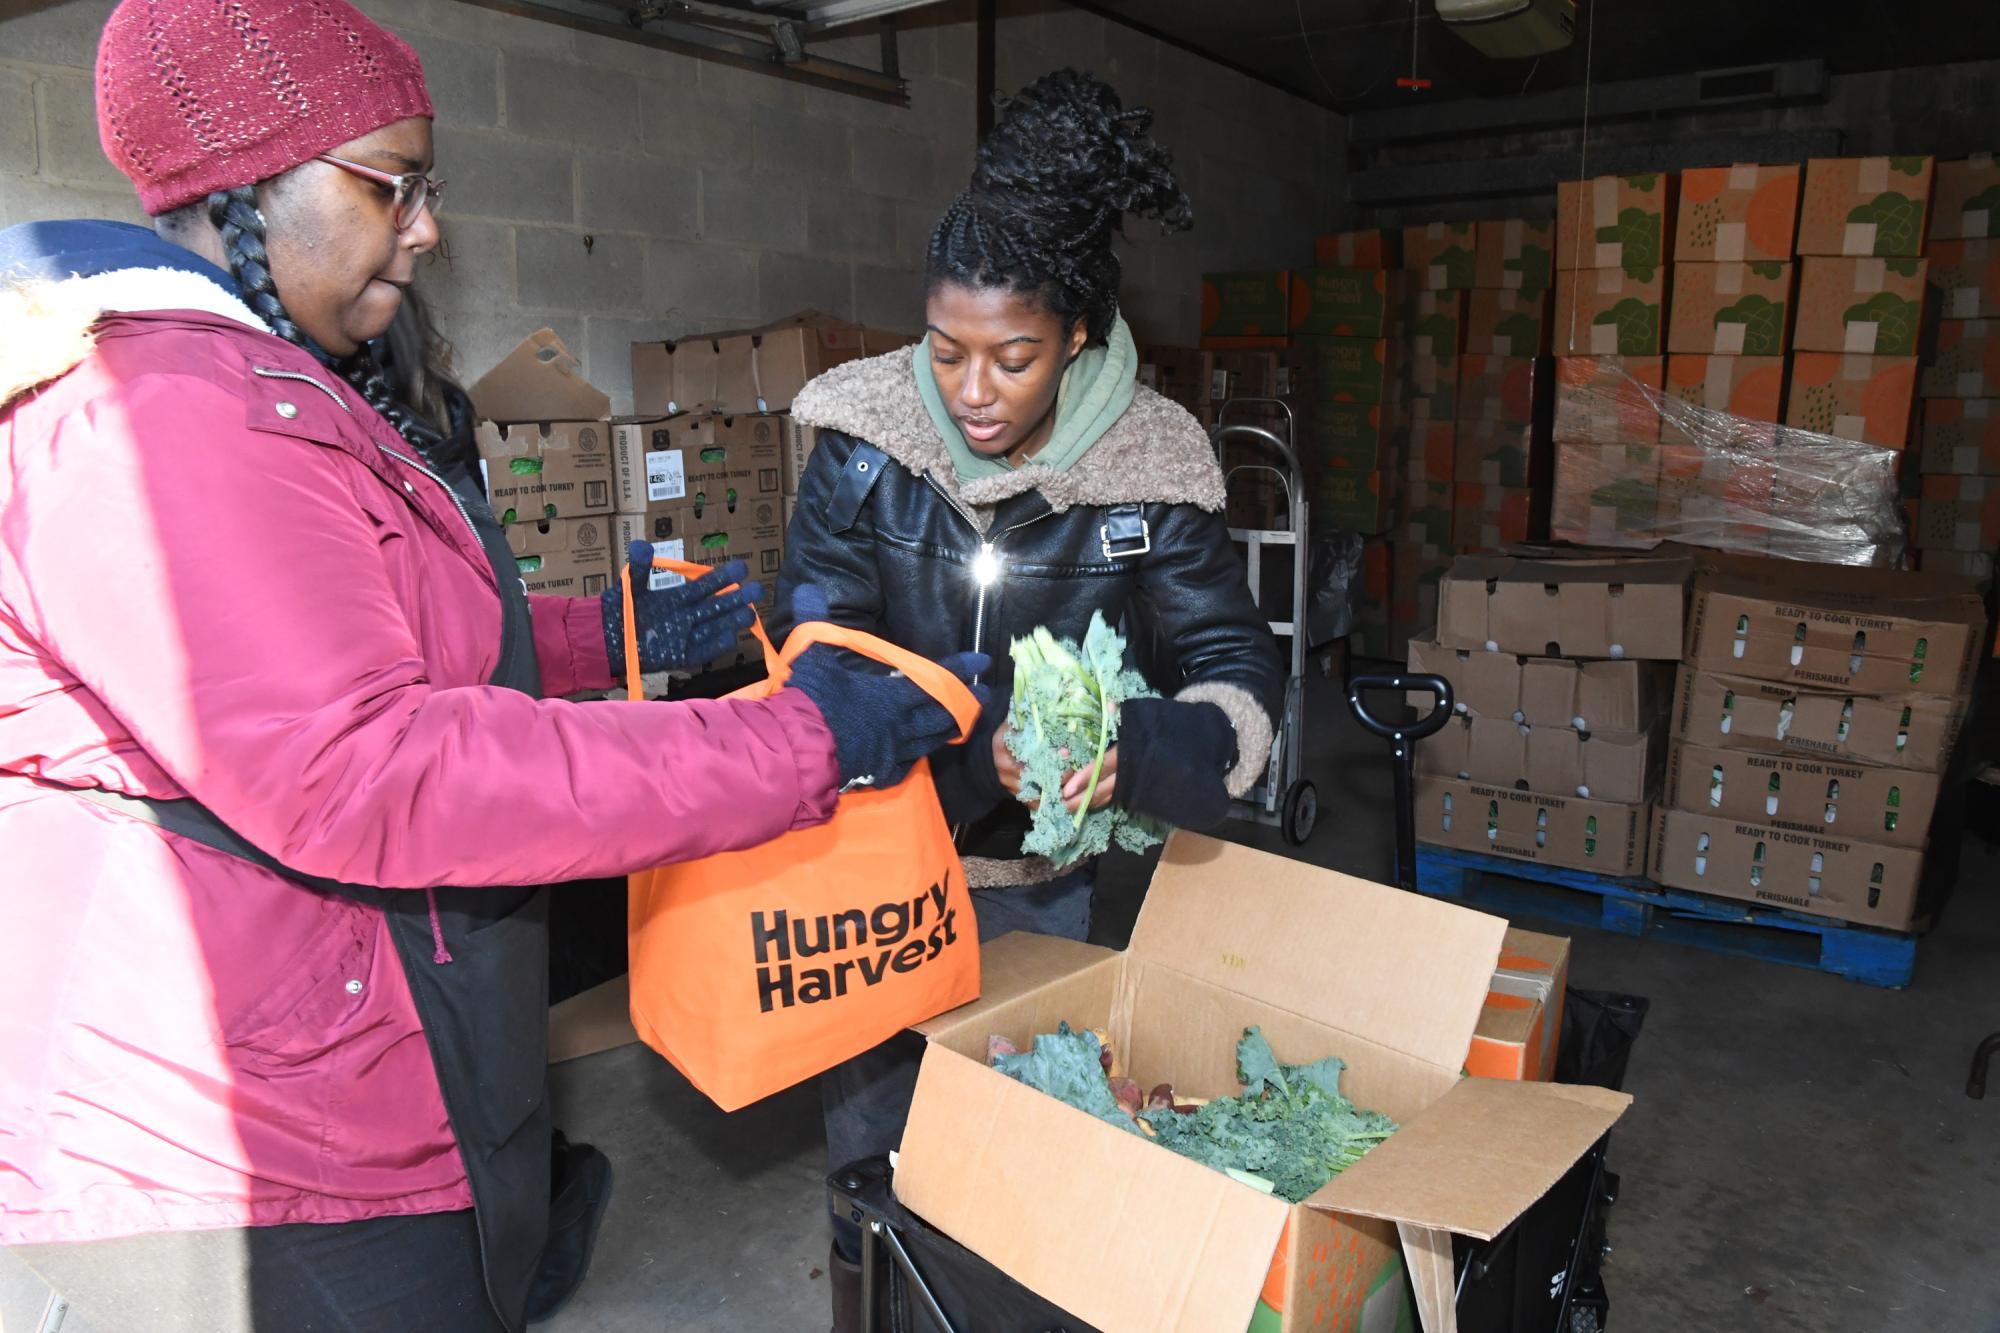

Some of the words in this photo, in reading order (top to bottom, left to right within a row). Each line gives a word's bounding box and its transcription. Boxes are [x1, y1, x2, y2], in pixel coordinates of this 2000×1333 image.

[619, 430, 629, 465] PRODUCT
[795, 424, 803, 451] RODUCT
[621, 466, 630, 478] OF
[494, 487, 518, 498] READY
[520, 486, 529, 495] TO
[549, 482, 575, 491] TURKEY
[623, 479, 632, 502] U.S.A.
[526, 580, 546, 592] COOK
[547, 578, 574, 589] TURKEY
[1775, 606, 1806, 619] READY
[1808, 612, 1822, 621] TO
[1824, 614, 1851, 625] COOK
[1854, 617, 1894, 631] TURKEY
[1794, 669, 1851, 686] PERISHABLE
[1760, 685, 1793, 696] READY
[1783, 735, 1838, 753] PERISHABLE
[1747, 757, 1778, 769] READY
[1781, 761, 1793, 771] TO
[1795, 763, 1823, 775] COOK
[1825, 766, 1864, 779] TURKEY
[1470, 786, 1495, 798] READY
[1497, 791, 1508, 799] TO
[1509, 792, 1533, 805] COOK
[1534, 797, 1566, 809] TURKEY
[1770, 820, 1825, 834] PERISHABLE
[1735, 825, 1766, 838] READY
[1769, 831, 1781, 841] TO
[1783, 833, 1811, 846] COOK
[1812, 838, 1851, 853] TURKEY
[1491, 844, 1536, 858] PERISHABLE
[1756, 890, 1810, 908] PERISHABLE
[750, 867, 950, 964] Hungry
[755, 908, 957, 1013] Harvest
